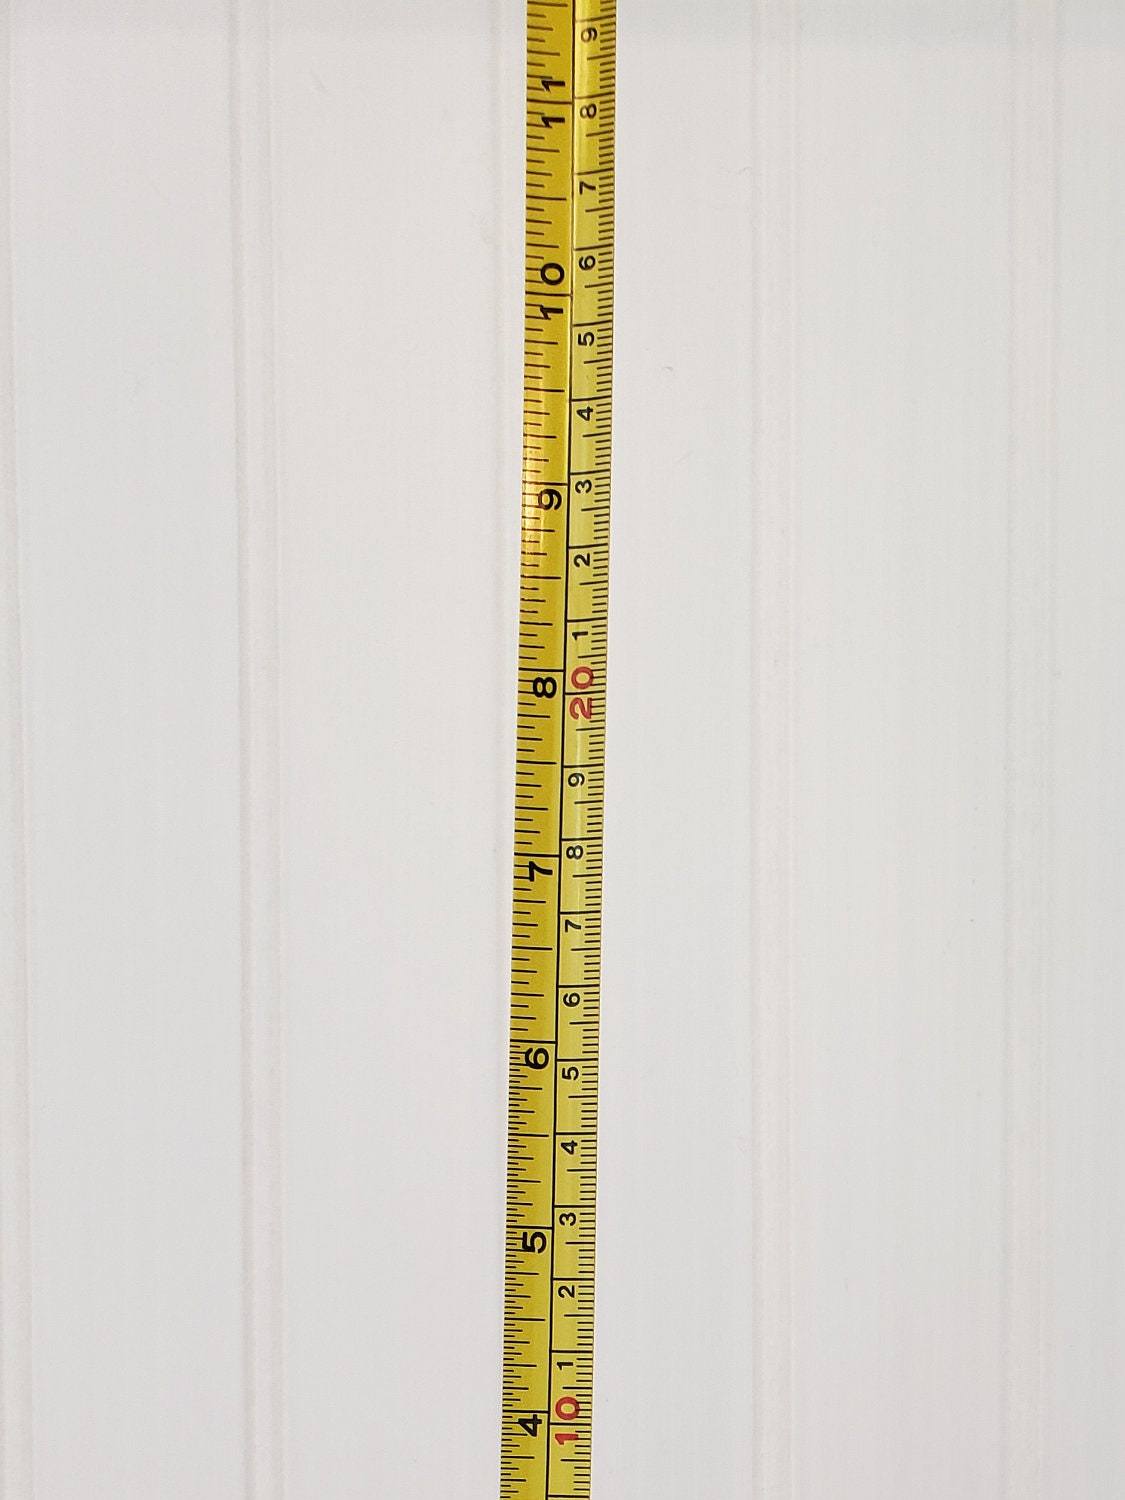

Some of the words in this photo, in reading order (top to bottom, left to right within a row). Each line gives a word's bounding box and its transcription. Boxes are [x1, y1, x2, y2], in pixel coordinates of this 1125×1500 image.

[581, 27, 598, 43] 9
[541, 80, 566, 129] 11
[580, 103, 597, 119] 8
[579, 181, 596, 195] 7
[579, 255, 595, 270] 6
[540, 263, 564, 319] 10
[578, 332, 594, 346] 5
[577, 407, 593, 421] 4
[575, 479, 592, 493] 3
[538, 488, 562, 510] 9
[574, 553, 590, 567] 2
[572, 631, 588, 640] 1
[533, 677, 557, 698] 8
[570, 666, 594, 720] 20
[568, 773, 585, 787] 9
[566, 845, 583, 859] 8
[529, 861, 553, 882] 7
[565, 919, 581, 932] 7
[563, 993, 580, 1007] 6
[525, 1047, 549, 1069] 6
[562, 1066, 579, 1080] 5
[561, 1140, 578, 1154] 4
[559, 1212, 576, 1226] 3
[522, 1232, 547, 1254] 5
[558, 1285, 575, 1298] 2
[557, 1361, 573, 1370] 1
[518, 1414, 542, 1437] 4
[555, 1397, 579, 1445] 10
